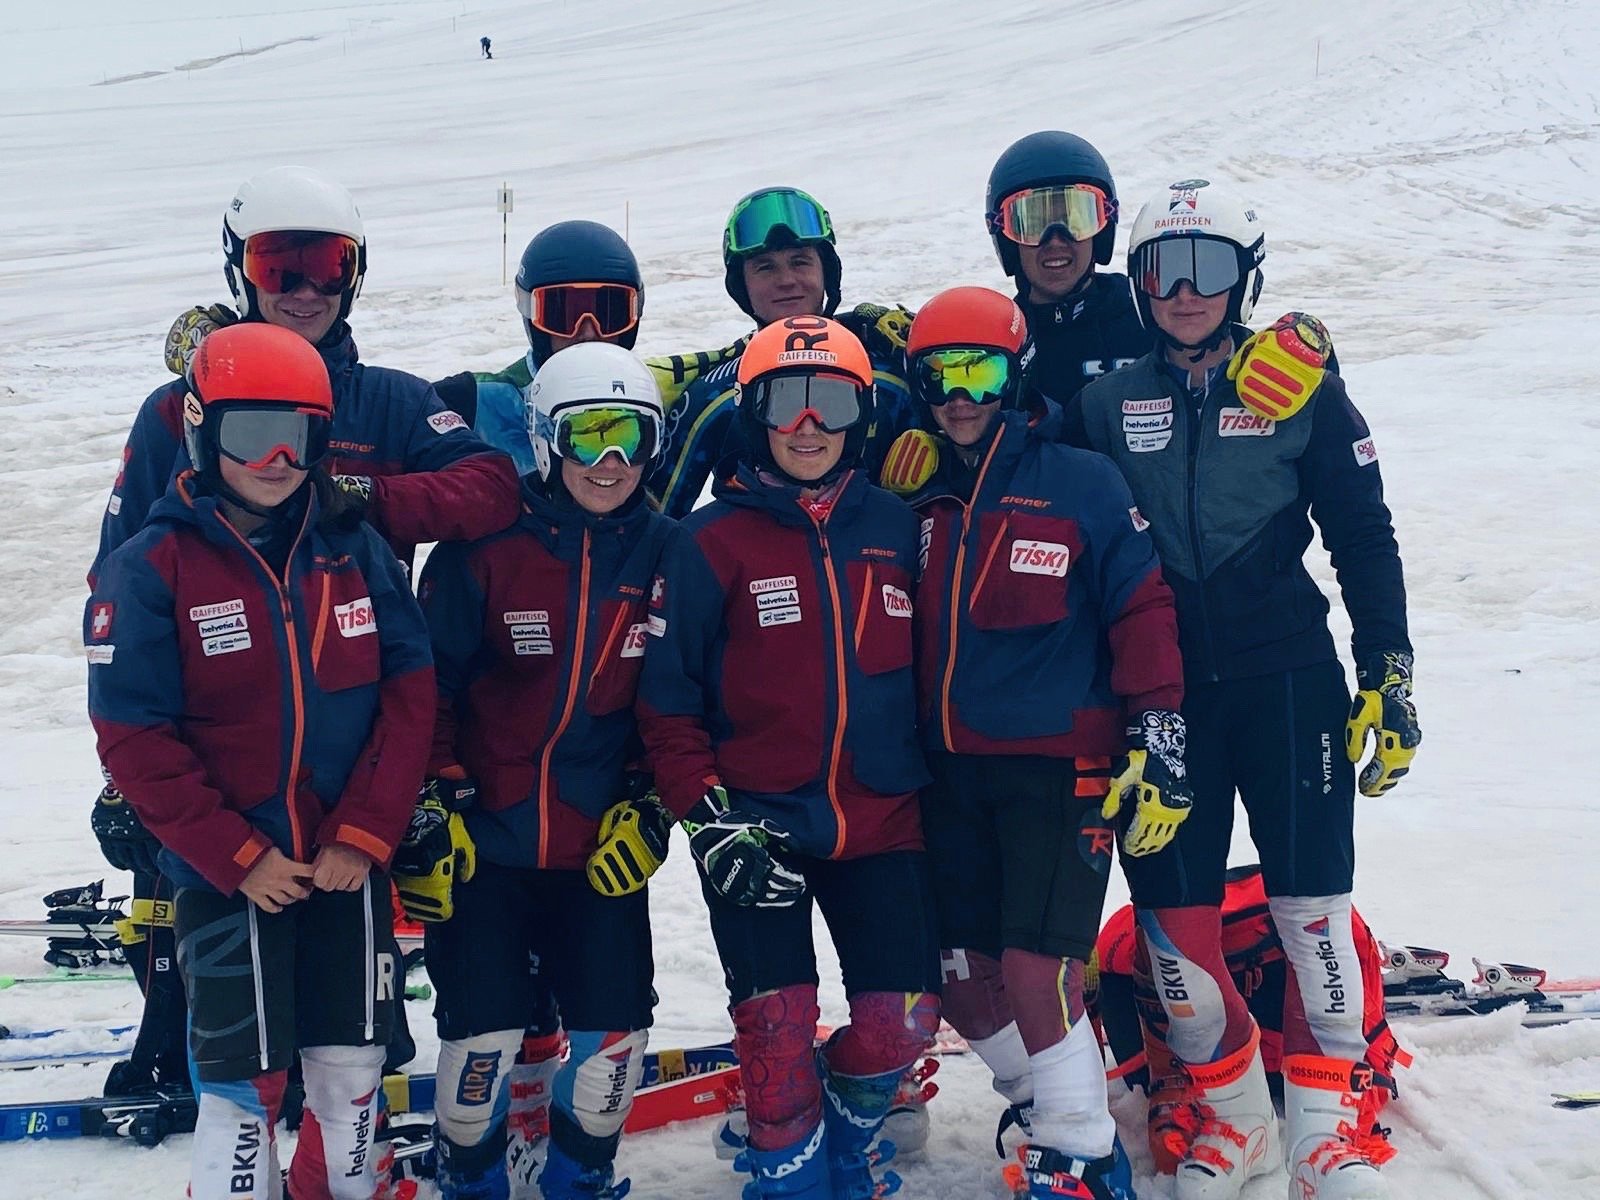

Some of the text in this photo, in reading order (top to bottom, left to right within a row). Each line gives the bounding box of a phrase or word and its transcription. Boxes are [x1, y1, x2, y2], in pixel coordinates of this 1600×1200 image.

[1154, 217, 1212, 229] RAIFFEISEN
[778, 351, 837, 362] RAIFFEISEN
[1124, 400, 1171, 412] RAIFFEISEN
[1125, 419, 1160, 429] helvetia
[751, 579, 795, 592] RAIFFEISEN
[758, 595, 788, 606] helvetia
[192, 602, 242, 618] RAIFFEISEN
[338, 603, 375, 630] TISK
[505, 613, 548, 622] RAIFFEISEN
[200, 621, 235, 634] helvetia
[1321, 733, 1331, 781] VITALINI
[721, 857, 744, 894] reusch
[1157, 954, 1189, 1001] BKW
[1316, 940, 1346, 1013] helvetia
[1195, 1057, 1248, 1085] ROSSIGNOL
[1290, 1065, 1347, 1083] ROSSIGNOL
[600, 1063, 628, 1114] helvetia
[345, 1108, 369, 1177] helvetia
[230, 1121, 261, 1193] BKW
